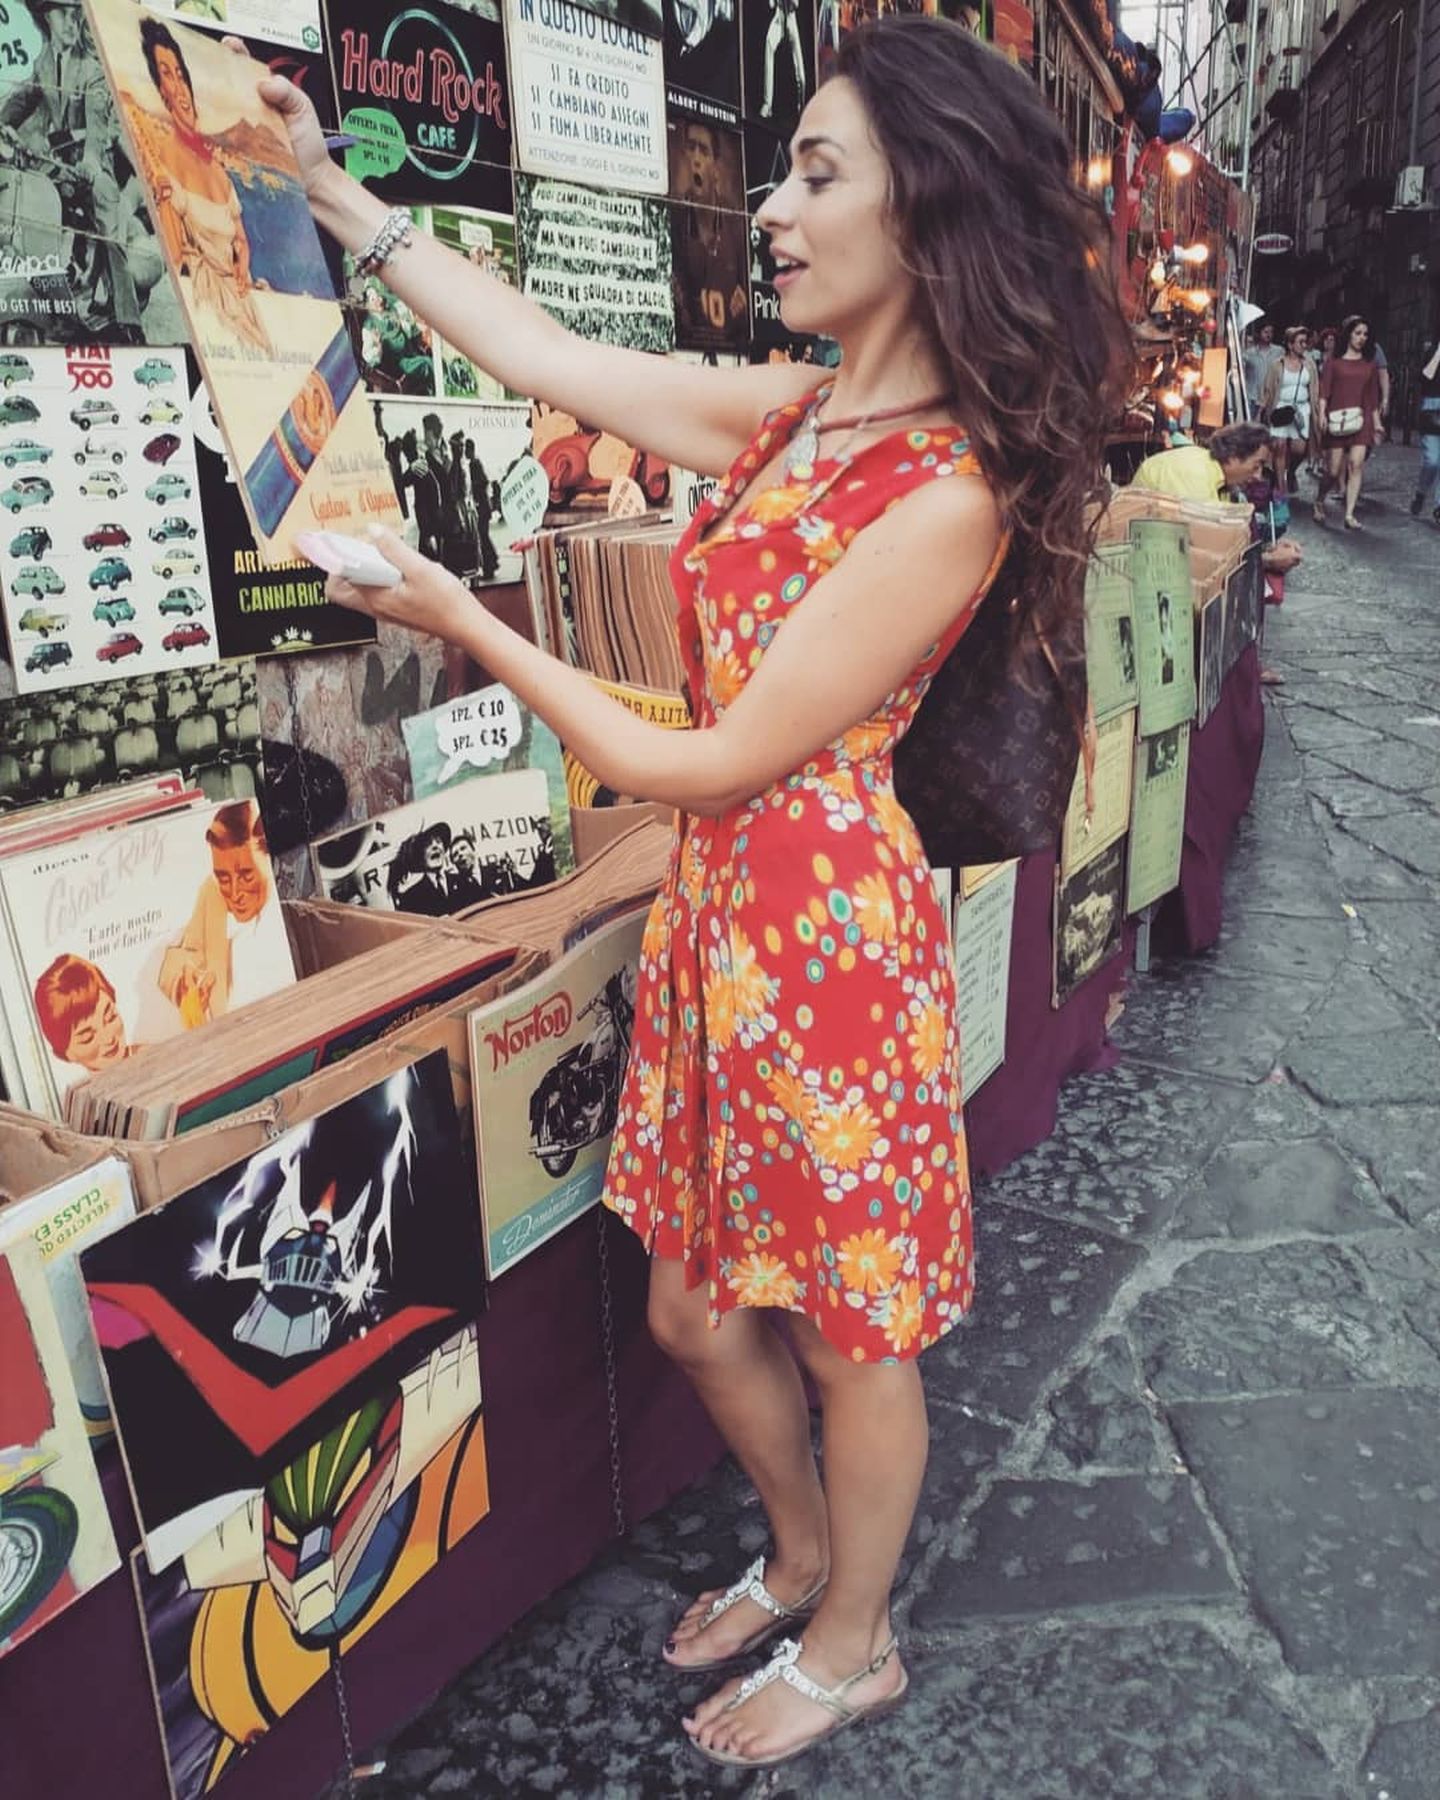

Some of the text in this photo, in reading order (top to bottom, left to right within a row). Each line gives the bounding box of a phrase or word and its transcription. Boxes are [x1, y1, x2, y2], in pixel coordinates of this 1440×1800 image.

[519, 0, 535, 22] IN
[540, 0, 597, 39] QUESTO
[1, 38, 29, 66] 25
[541, 36, 574, 55] GIORNO
[341, 28, 507, 130] Hard Rock
[551, 63, 630, 100] SI FA CREDITO
[531, 85, 650, 130] SI CAMBIANO ASSEGNI
[667, 91, 737, 124] ALBERT EINSTEIN
[417, 122, 458, 150] CAFE
[531, 111, 652, 155] SI FUMA LIBERAMENTE
[556, 190, 598, 211] CAMBIARE
[540, 229, 556, 247] MA
[558, 232, 576, 250] NON
[600, 239, 641, 262] CAMBIARE
[10, 299, 30, 313] GET
[32, 299, 52, 314] THE
[53, 299, 77, 315] BEST
[531, 276, 565, 300] MADRE
[583, 282, 624, 305] SQUADRA
[625, 289, 635, 306] DI
[67, 362, 113, 393] 500
[490, 699, 504, 717] 10
[491, 726, 508, 748] 25
[87, 942, 110, 961] non
[484, 990, 573, 1072] Norton
[53, 1187, 102, 1229] CLASS
[56, 1200, 111, 1244] SELECTED
